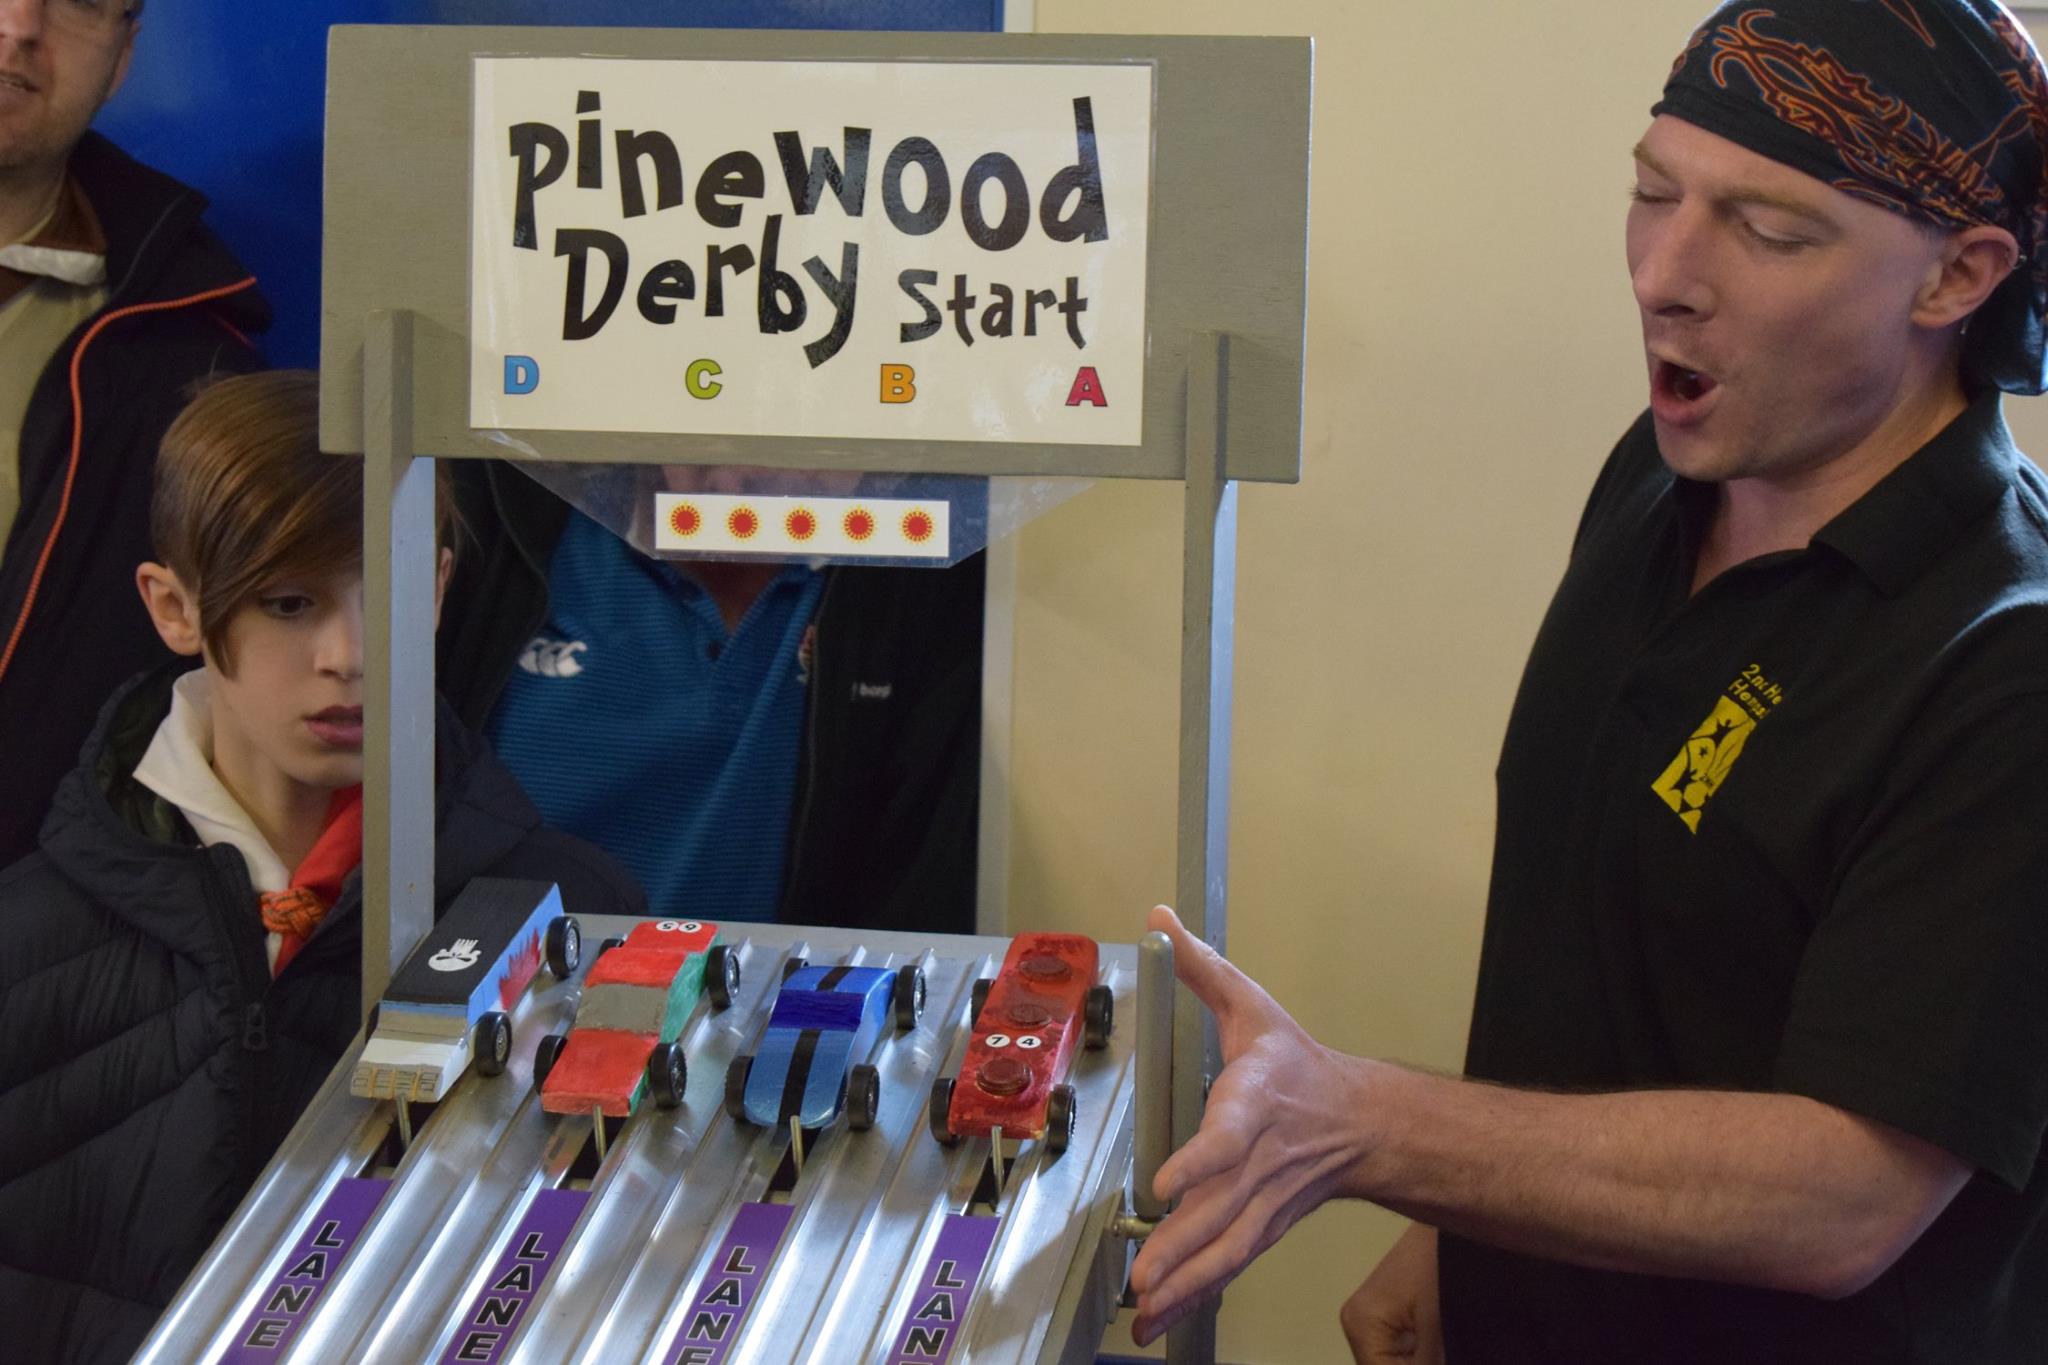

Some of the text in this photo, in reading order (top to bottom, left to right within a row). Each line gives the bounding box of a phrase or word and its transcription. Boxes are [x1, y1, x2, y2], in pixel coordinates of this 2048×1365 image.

[554, 213, 1088, 369] Derby Start
[503, 356, 1108, 408] D C B A
[243, 1219, 344, 1348] LANE
[455, 1231, 549, 1361] LANE
[898, 1259, 966, 1365] LAN
